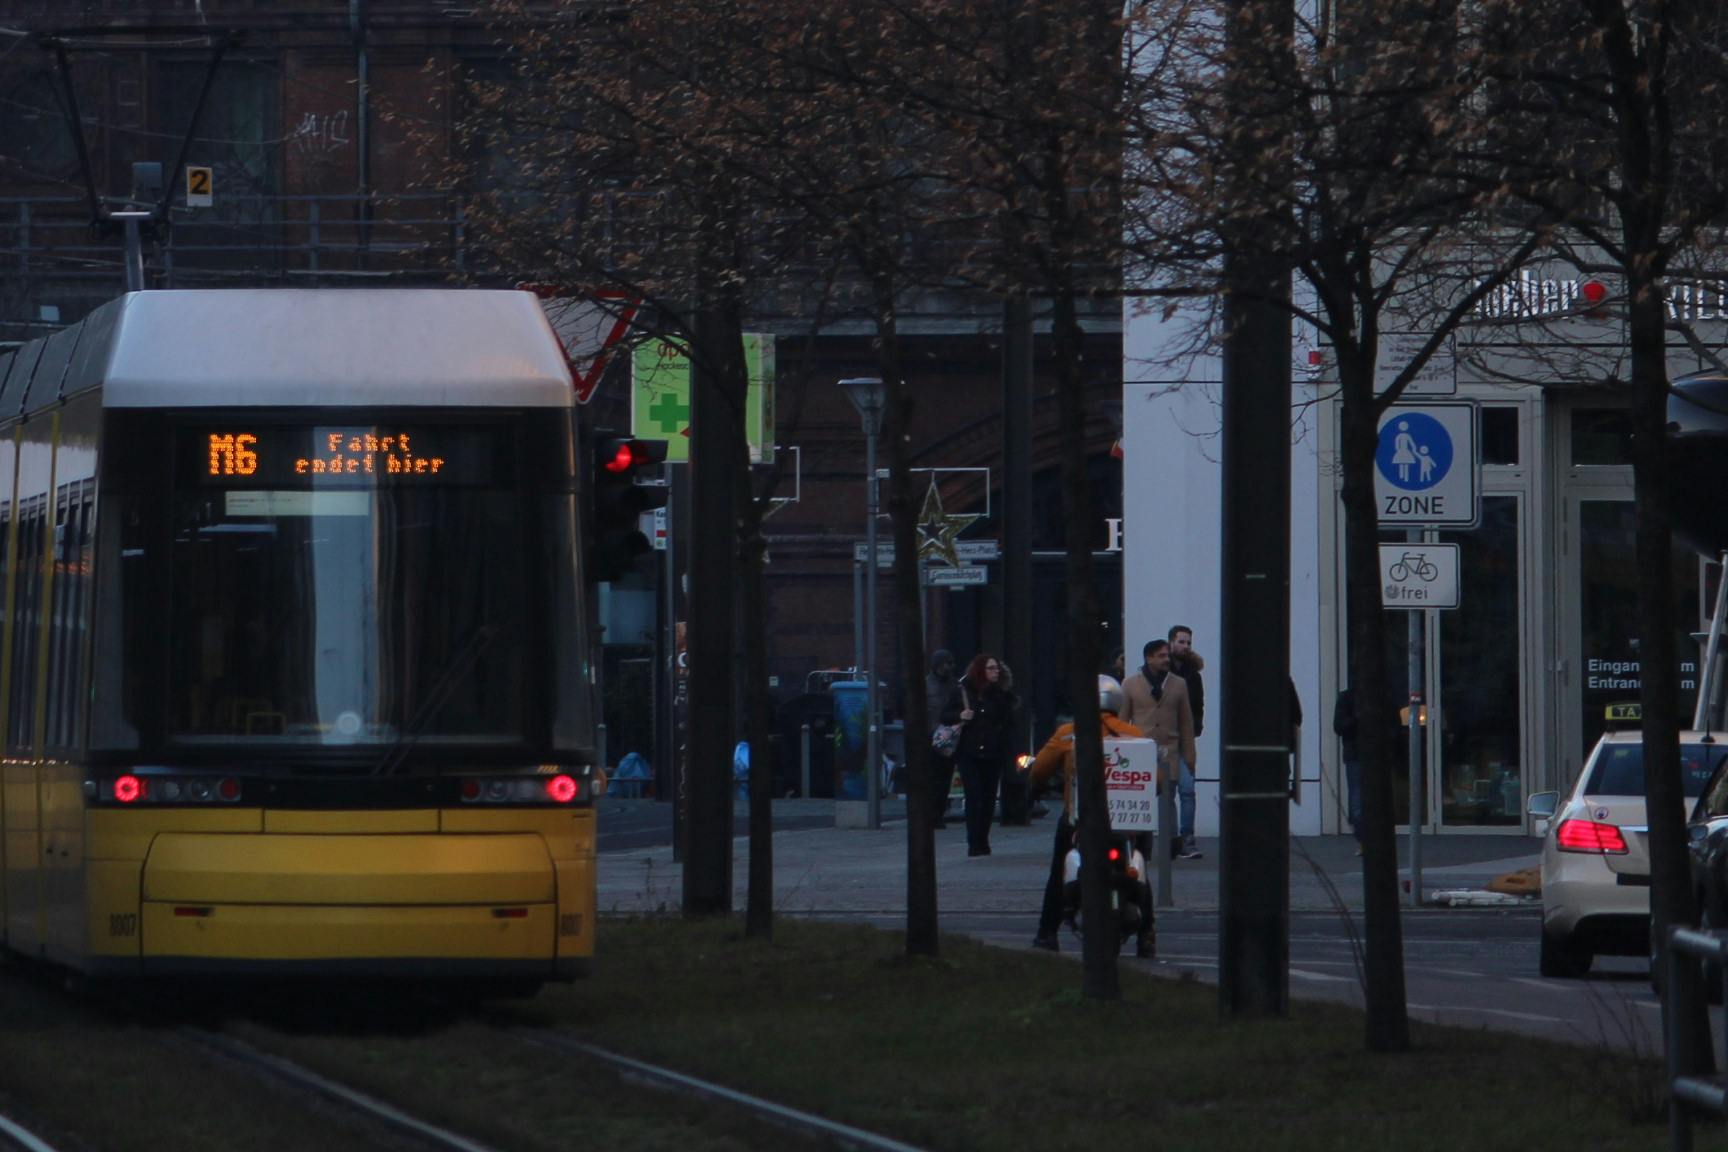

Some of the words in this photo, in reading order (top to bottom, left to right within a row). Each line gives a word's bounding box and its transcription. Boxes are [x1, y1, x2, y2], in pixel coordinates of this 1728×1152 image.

[192, 170, 208, 195] 2
[209, 433, 258, 475] M6
[328, 433, 411, 452] Fahrt
[295, 454, 376, 474] endet
[386, 454, 444, 474] hier
[1385, 496, 1444, 514] ZONE
[1401, 586, 1428, 600] frei
[1588, 659, 1640, 674] Eingan
[1618, 706, 1642, 716] TA
